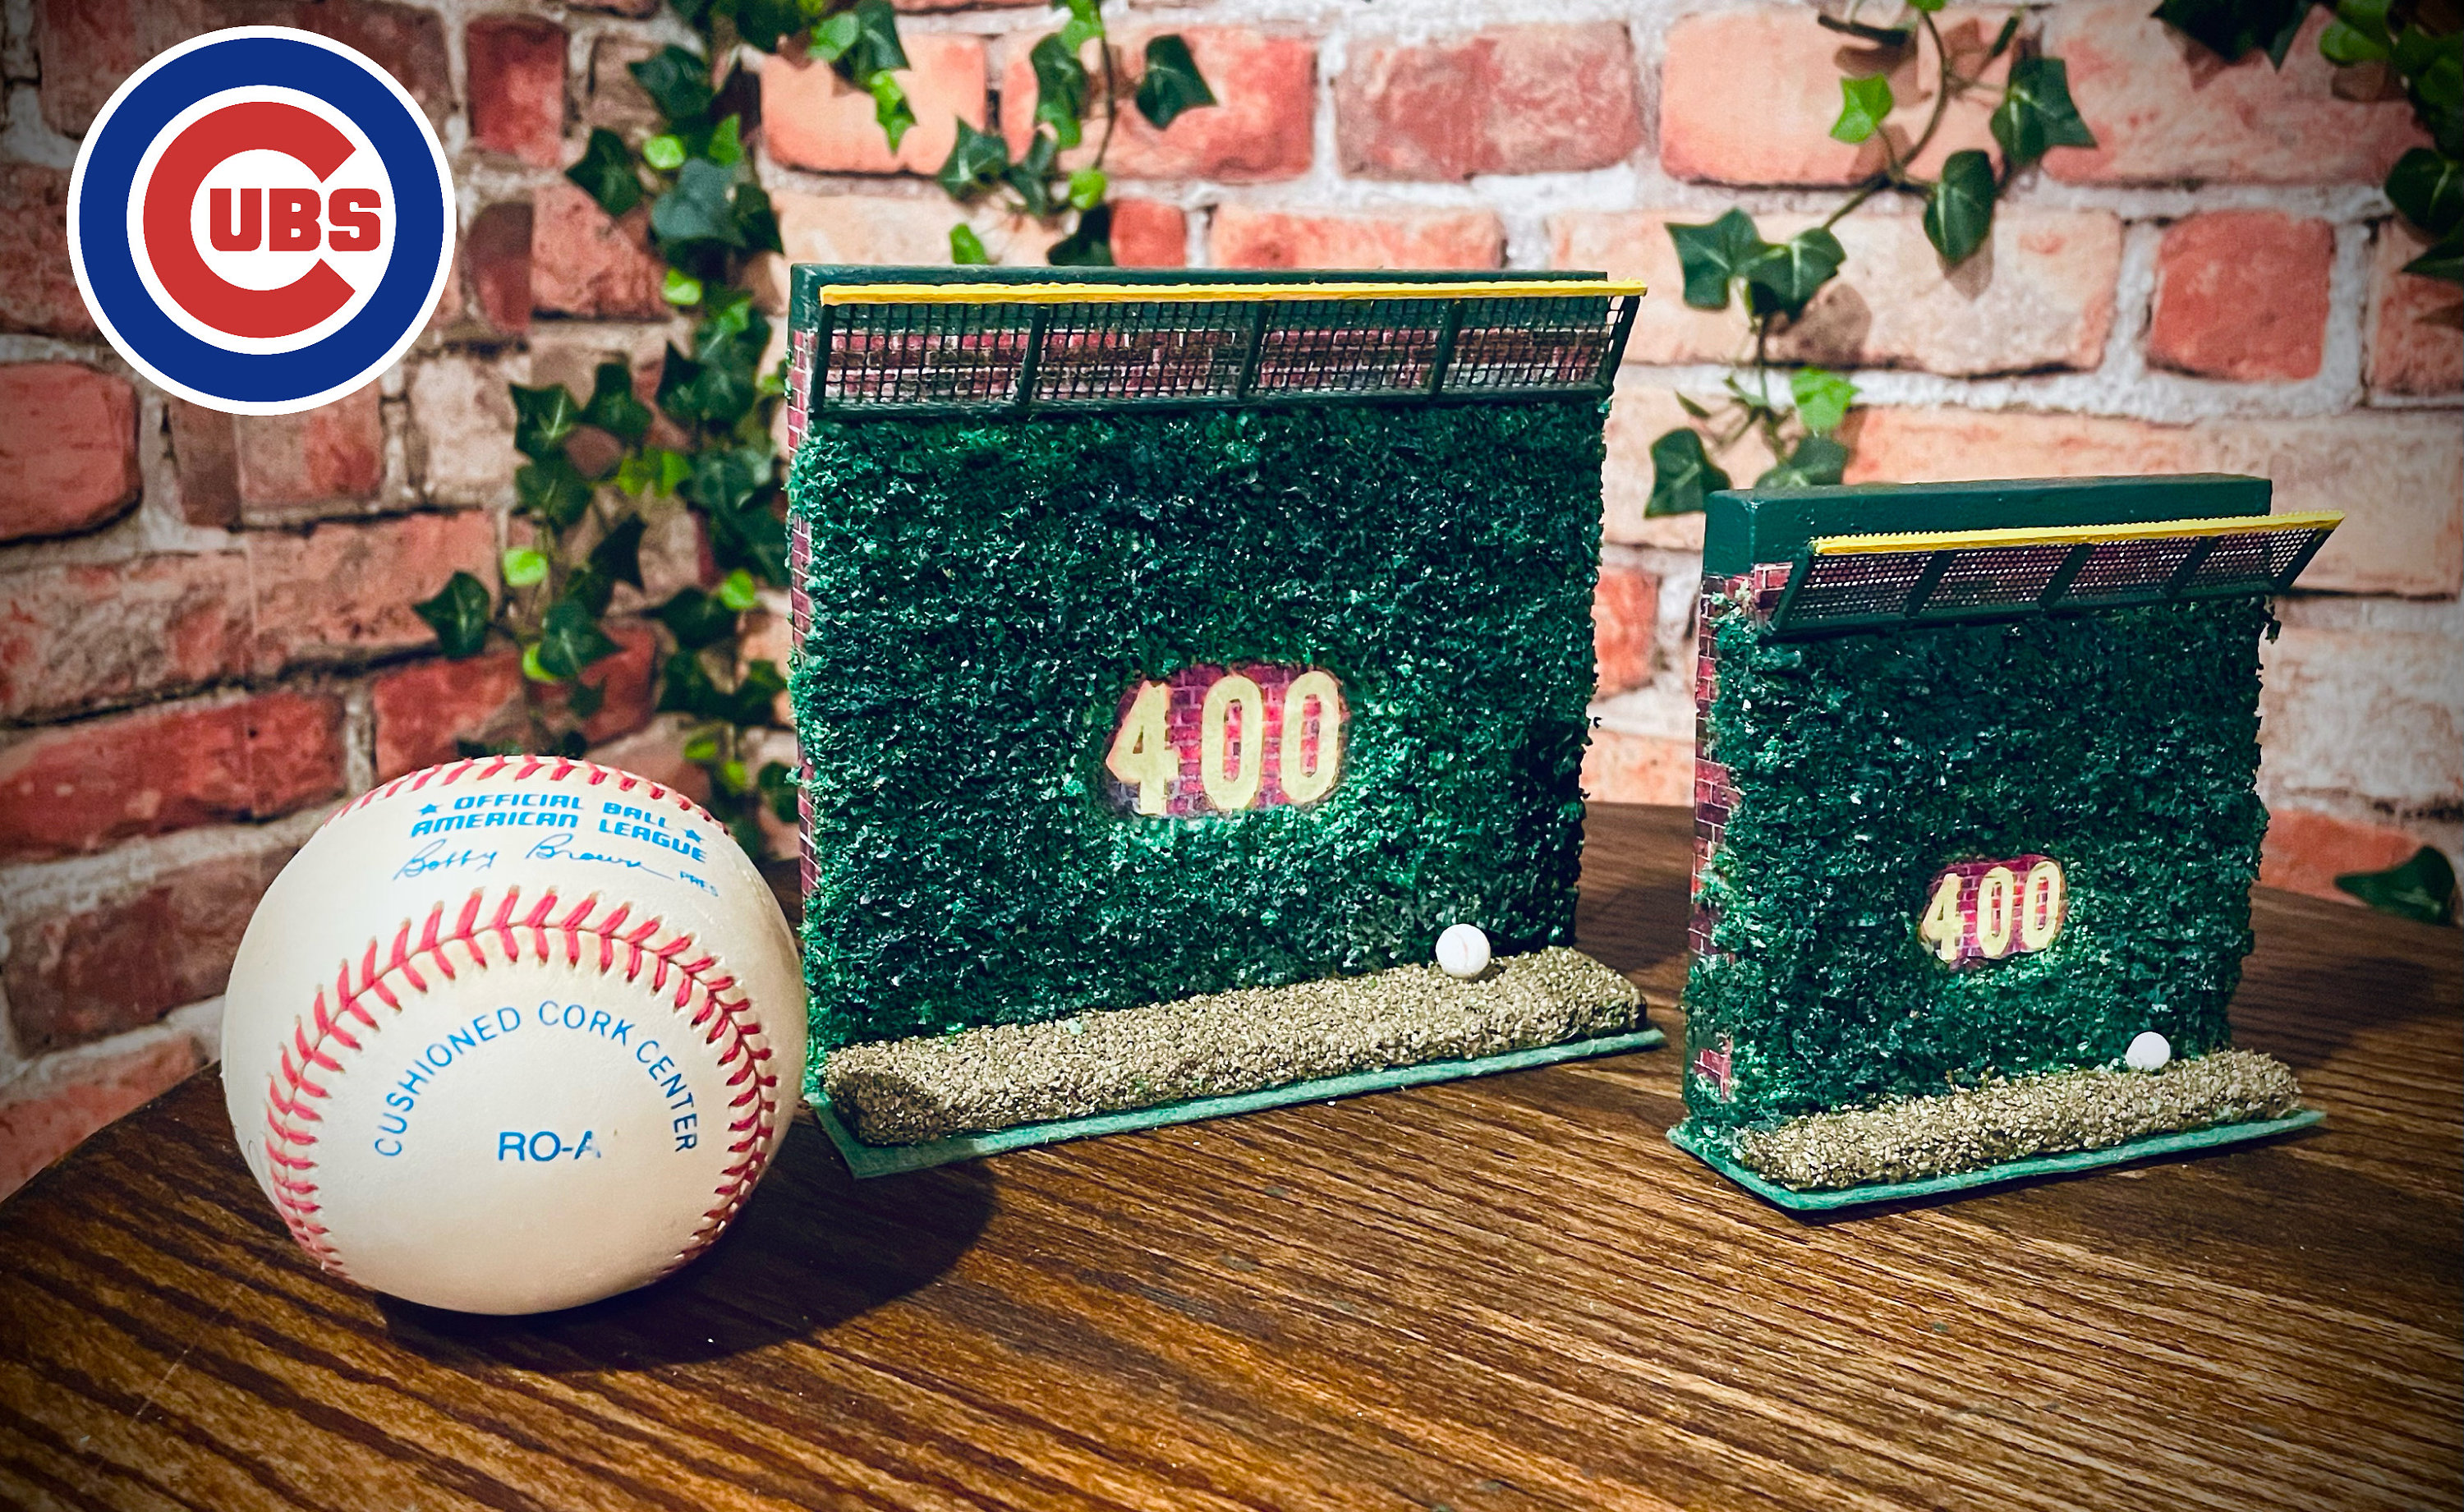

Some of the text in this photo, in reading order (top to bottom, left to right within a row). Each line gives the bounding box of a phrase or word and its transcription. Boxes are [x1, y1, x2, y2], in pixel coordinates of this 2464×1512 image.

[1106, 671, 1340, 815] 400
[411, 811, 707, 863] AMERICAN LEAGUE
[453, 793, 667, 828] OFFICIAL BALL
[1923, 861, 2060, 961] 400
[375, 1000, 698, 1156] CUSHIONED CORK CENTER
